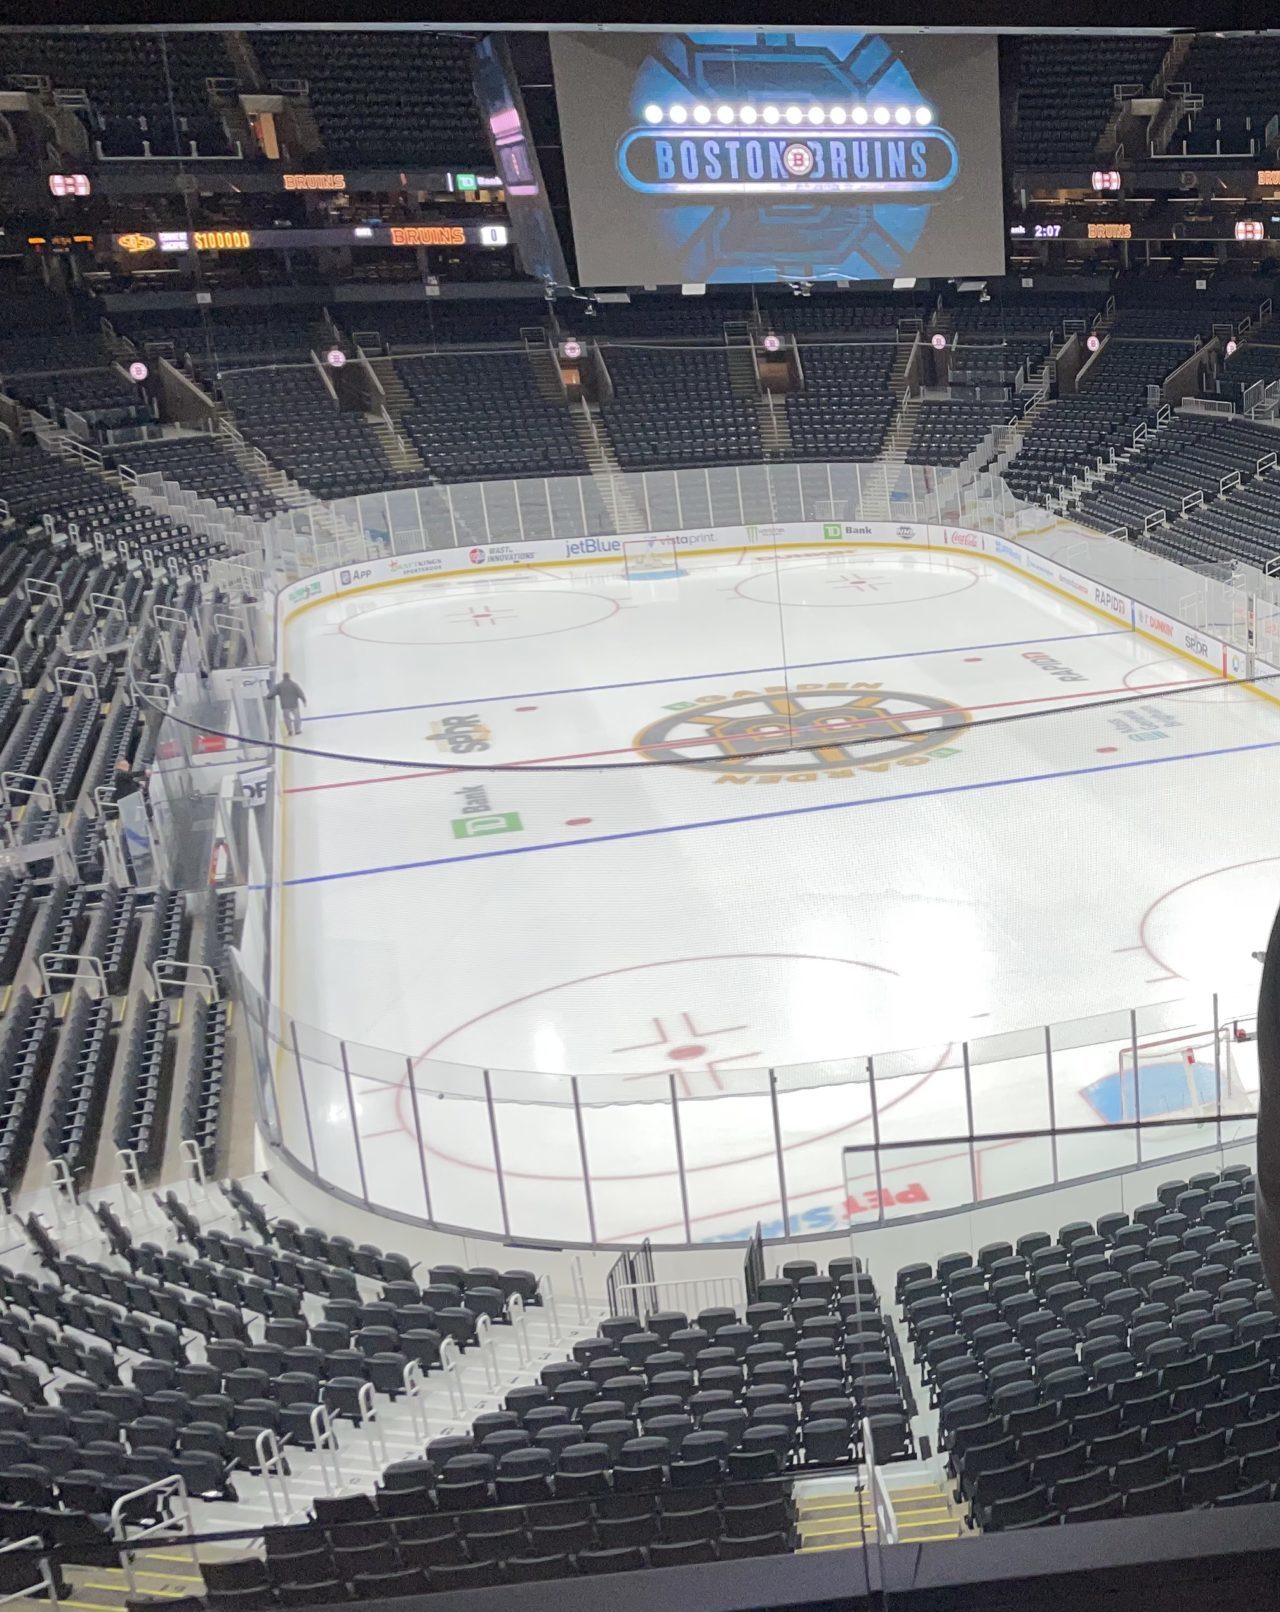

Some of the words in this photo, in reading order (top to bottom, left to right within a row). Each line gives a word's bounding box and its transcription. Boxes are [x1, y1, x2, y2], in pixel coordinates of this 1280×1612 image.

[655, 140, 790, 180] BOSTON
[806, 140, 928, 179] BRUINS
[283, 174, 346, 190] BRUINS
[391, 227, 466, 245] BRUINS
[1034, 225, 1062, 238] 2:07
[1087, 224, 1132, 238] BRUINS
[845, 526, 872, 536] Bank
[565, 538, 621, 558] jetBlue
[454, 784, 491, 815] Bank
